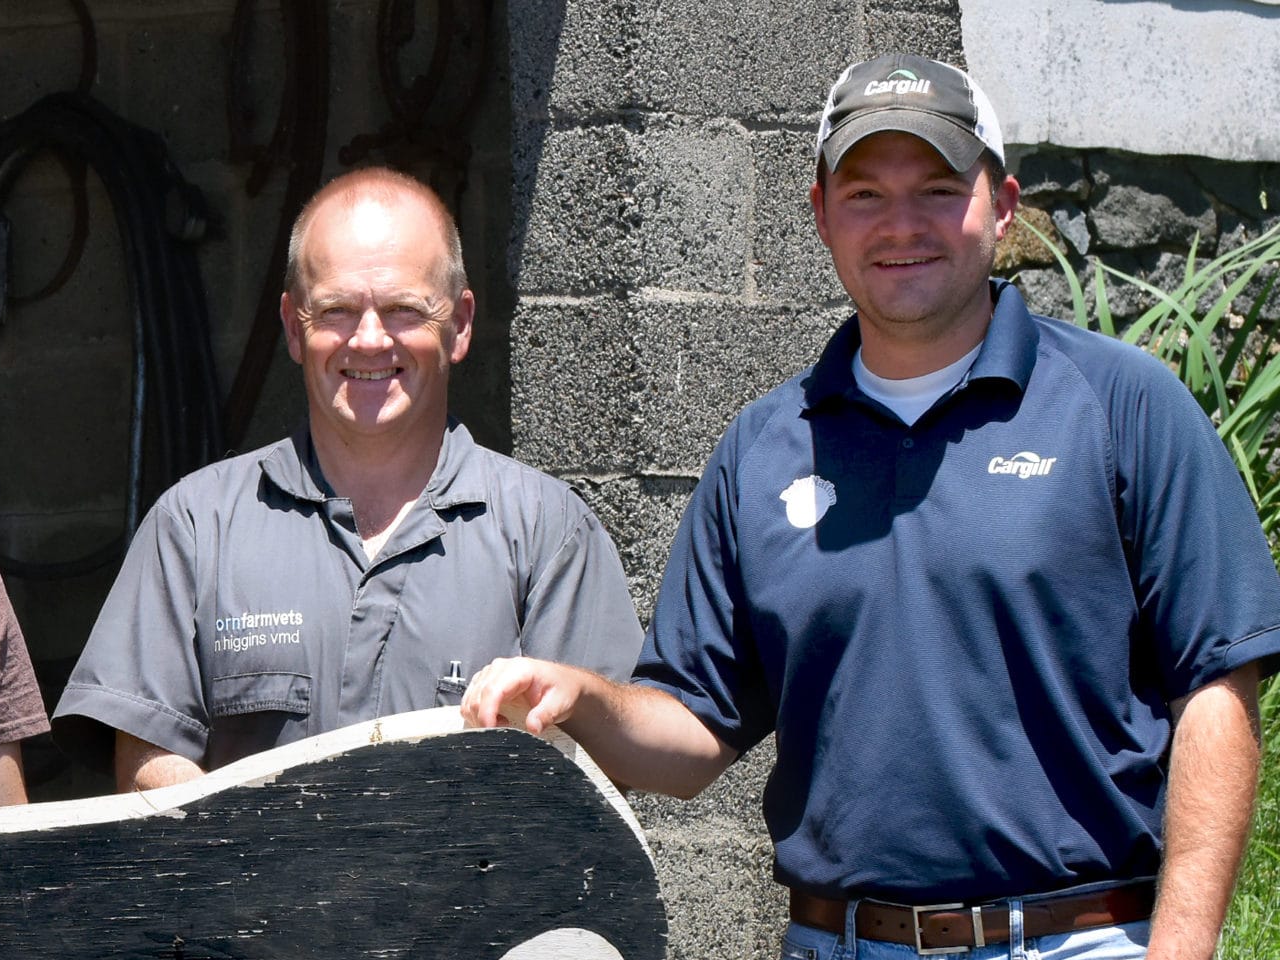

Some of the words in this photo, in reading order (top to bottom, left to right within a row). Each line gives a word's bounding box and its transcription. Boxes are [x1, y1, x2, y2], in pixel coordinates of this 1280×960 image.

[864, 78, 931, 96] Cargill
[987, 452, 1057, 479] Cargill
[223, 632, 267, 652] higgins
[270, 630, 300, 644] vmd
